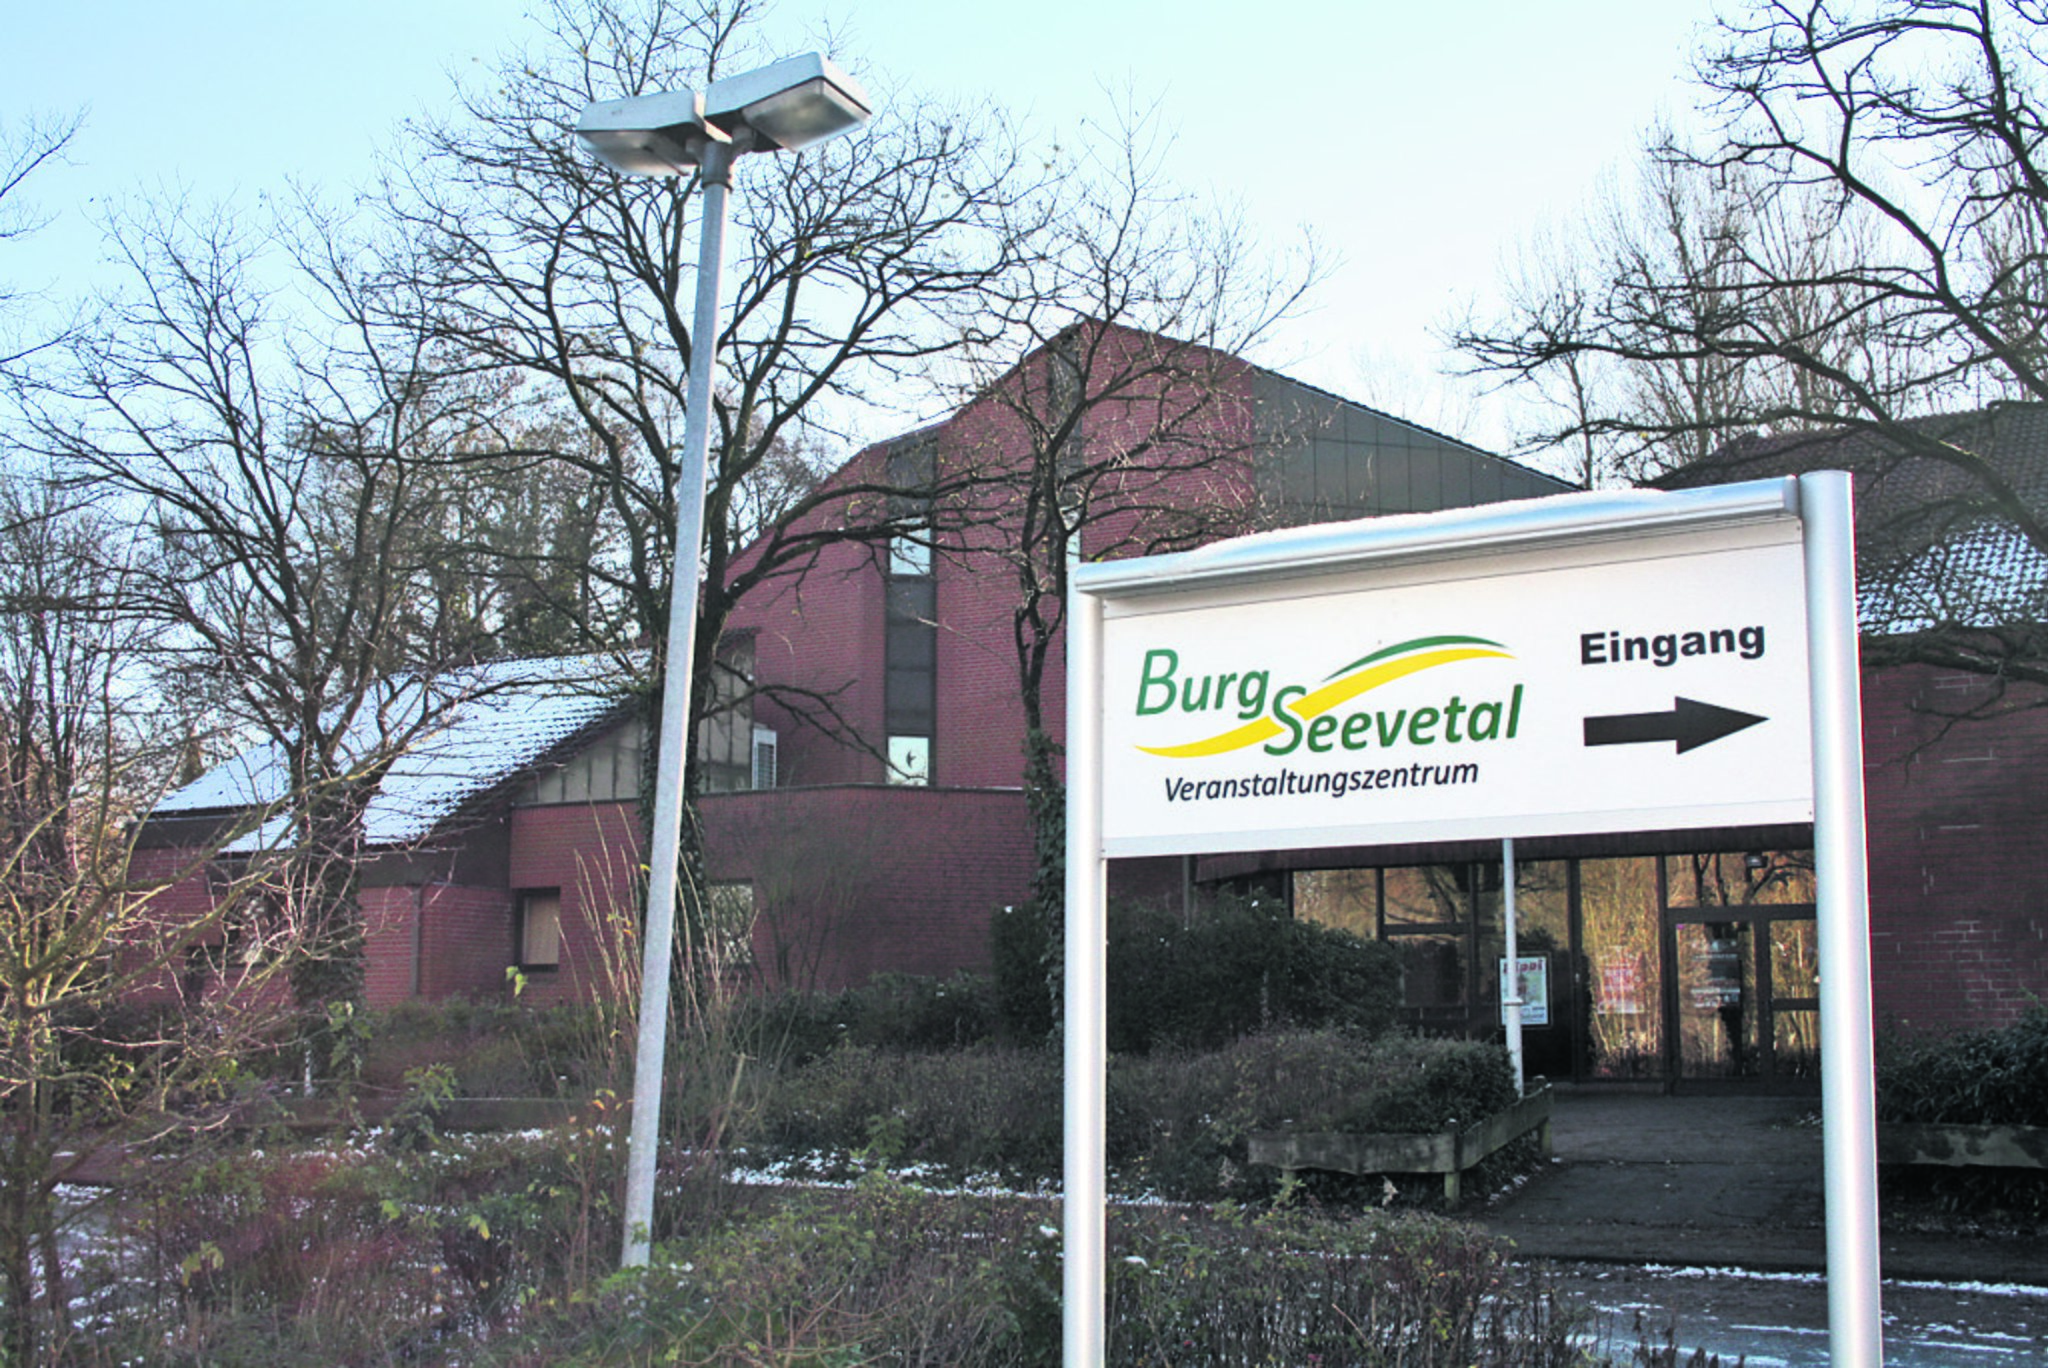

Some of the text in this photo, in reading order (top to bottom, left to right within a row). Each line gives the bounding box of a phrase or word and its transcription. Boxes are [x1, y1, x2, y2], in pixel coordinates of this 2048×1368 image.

[1580, 626, 1765, 667] Eingang
[1136, 649, 1523, 756] Burg Seevetal
[1165, 762, 1479, 802] Veranstaltungszentrum
